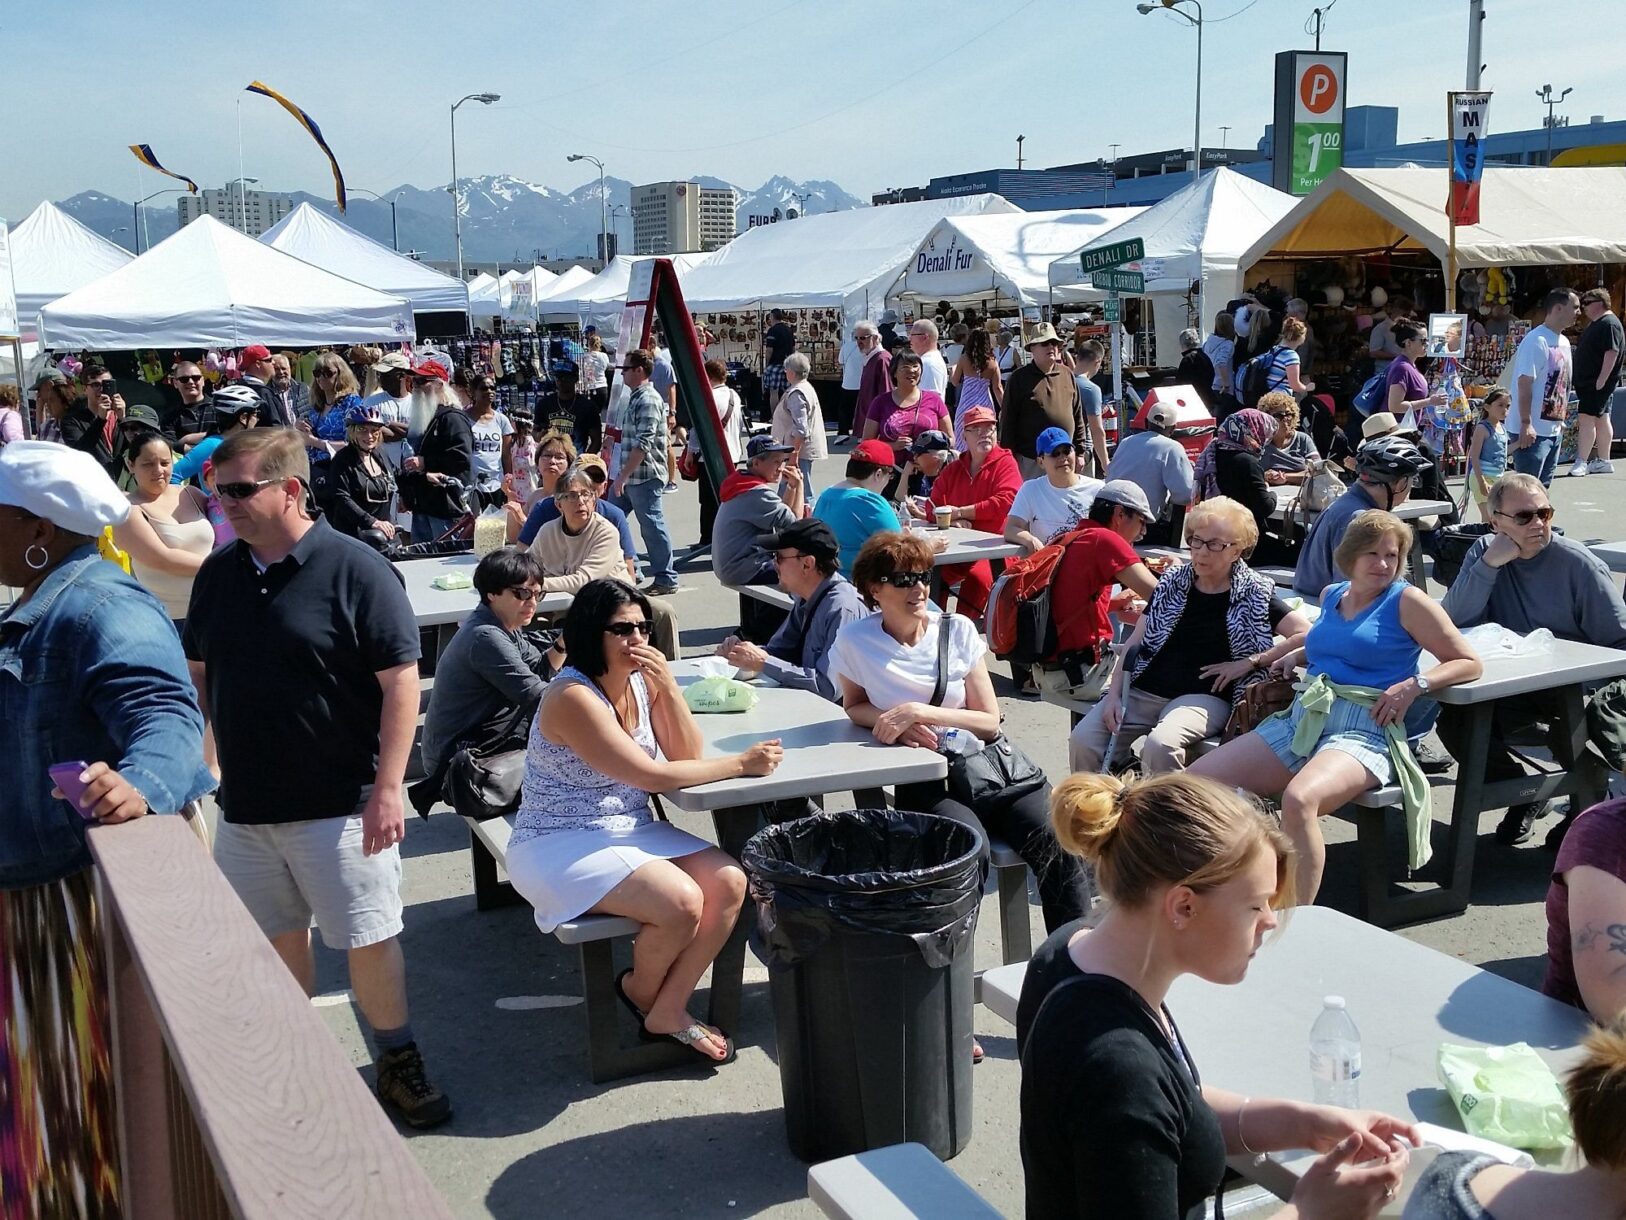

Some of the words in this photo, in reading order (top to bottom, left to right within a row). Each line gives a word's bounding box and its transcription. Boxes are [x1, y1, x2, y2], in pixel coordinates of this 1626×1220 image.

[1309, 74, 1330, 106] P
[1455, 98, 1489, 106] RUSSIAN
[1206, 151, 1228, 160] EasyPark
[1300, 178, 1312, 187] Per
[917, 248, 952, 274] Denali
[955, 248, 973, 270] Fur
[1085, 247, 1121, 268] DENALI
[1126, 243, 1139, 258] DR
[1113, 274, 1142, 290] CORRIDOR
[474, 442, 501, 452] ELLA
